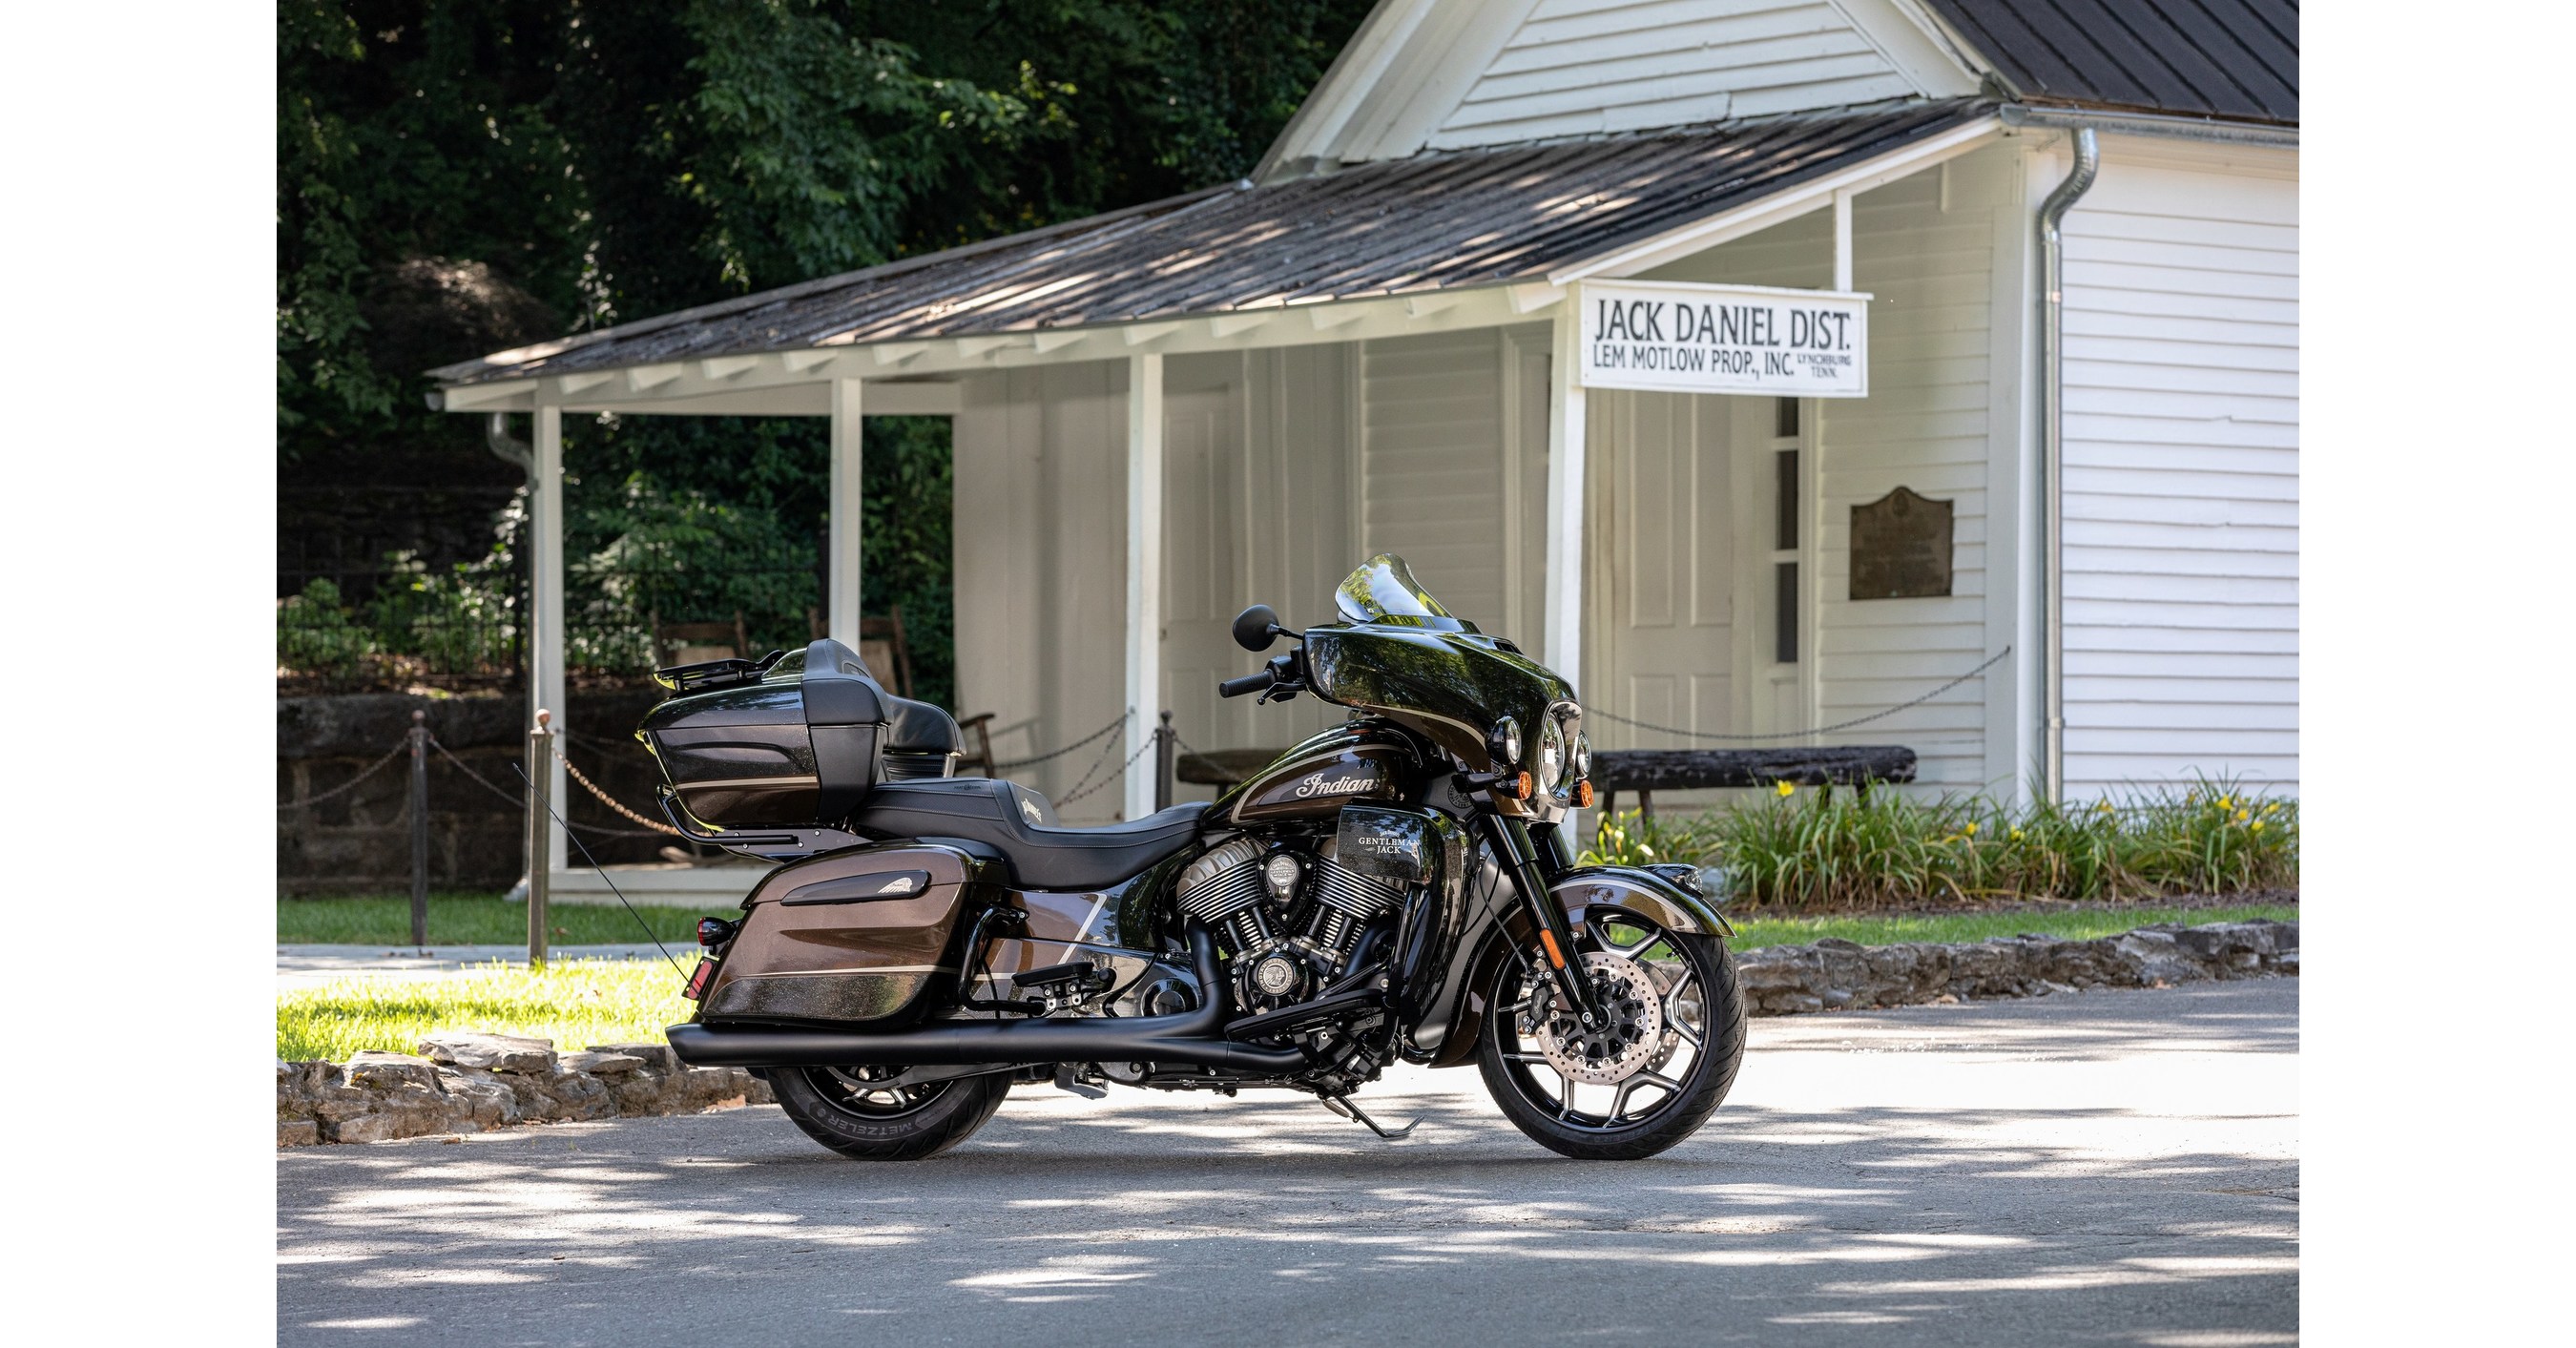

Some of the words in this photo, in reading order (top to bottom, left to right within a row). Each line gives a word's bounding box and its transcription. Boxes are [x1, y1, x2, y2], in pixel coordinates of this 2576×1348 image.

[1594, 299, 1666, 342] JACK
[1674, 303, 1780, 346] DANIEL
[1790, 309, 1851, 351] DIST.
[1592, 344, 1626, 368] LEM
[1631, 345, 1705, 372] MOTLOW
[1712, 350, 1760, 381] PROP.,
[1764, 352, 1795, 376] INC.
[1295, 773, 1375, 798] Indian
[1358, 837, 1421, 846] GENTLEMAN
[1376, 845, 1402, 855] JACK
[827, 1114, 912, 1135] METZELER
